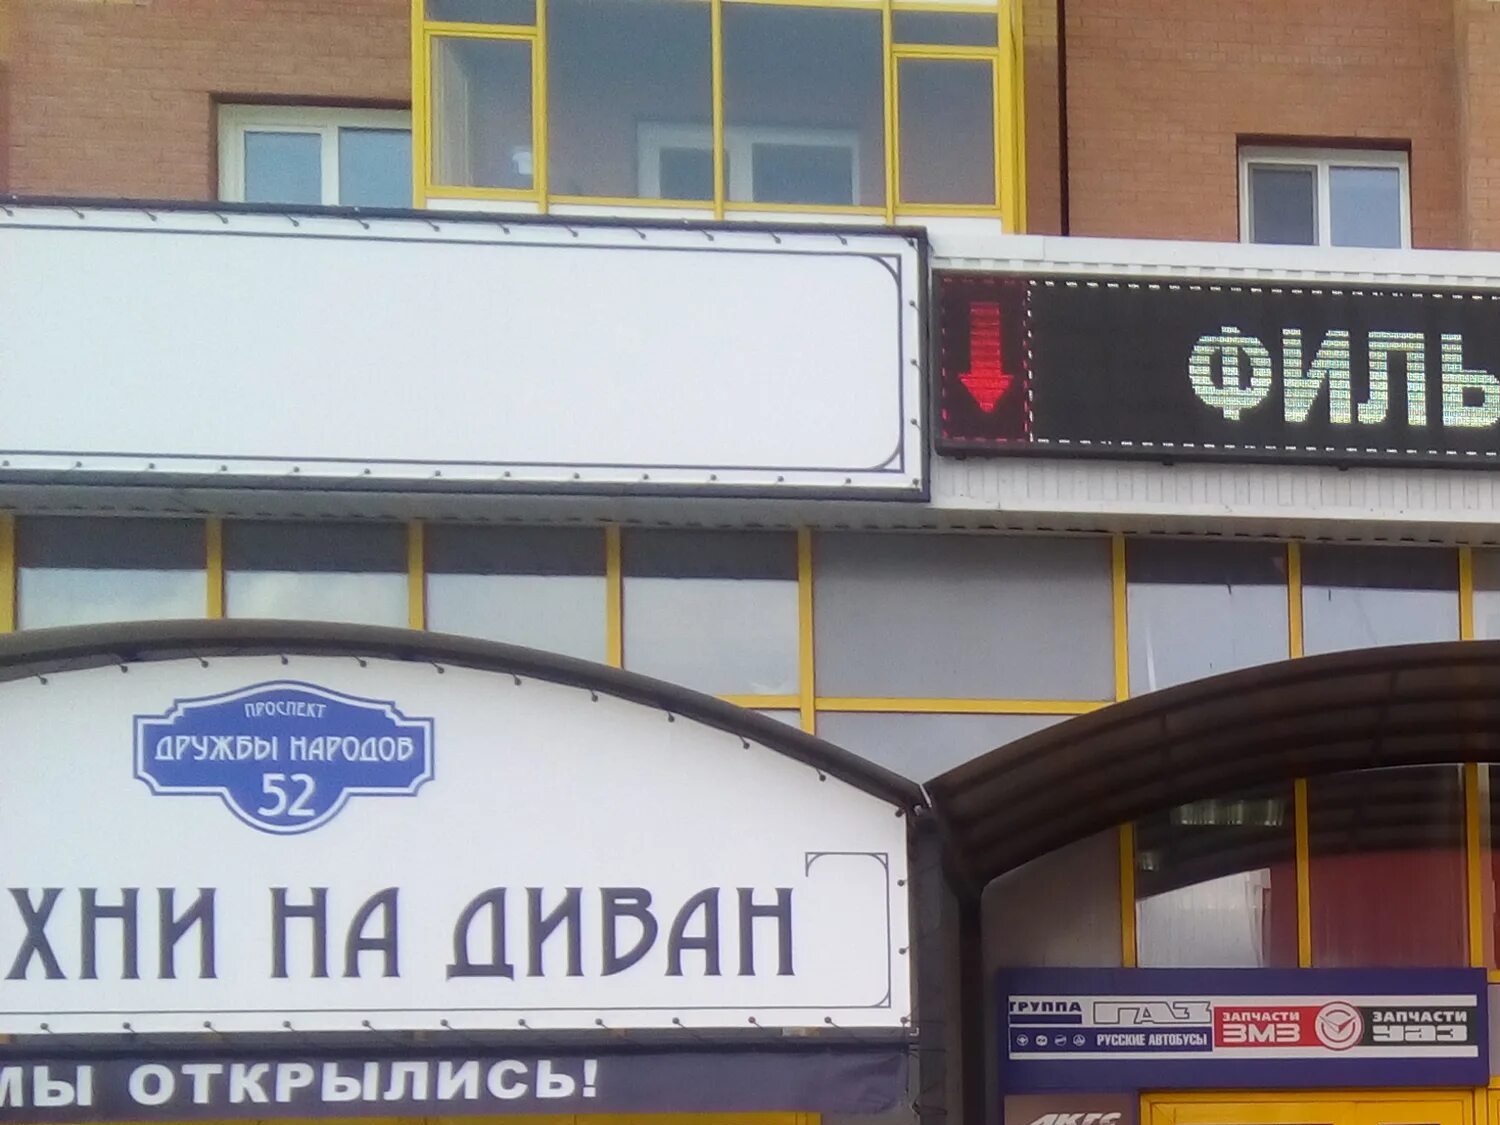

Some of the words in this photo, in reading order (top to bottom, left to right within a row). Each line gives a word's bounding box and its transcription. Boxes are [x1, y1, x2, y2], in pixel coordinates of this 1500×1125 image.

[244, 700, 327, 719] ПРОСПЕКТ
[154, 735, 279, 762] ДРУЖБЫ
[290, 735, 414, 762] НАРОДОВ
[257, 772, 316, 818] 52
[4, 885, 219, 982] ХНИ
[269, 886, 402, 980] НА
[445, 886, 797, 982] ДИВАН
[1009, 1000, 1083, 1013] ГРУППА
[1092, 1001, 1212, 1025] ГАЗ
[1222, 1011, 1301, 1023] ЗАПЧАСТИ
[1372, 1011, 1468, 1023] ЗАПЧАСТИ
[1096, 1033, 1146, 1047] РУССКИЕ
[1148, 1033, 1208, 1046] АВТОБУСЫ
[1223, 1023, 1301, 1043] ЗМЗ
[128, 1058, 599, 1106] ОТКРЫЛИСЬ!
